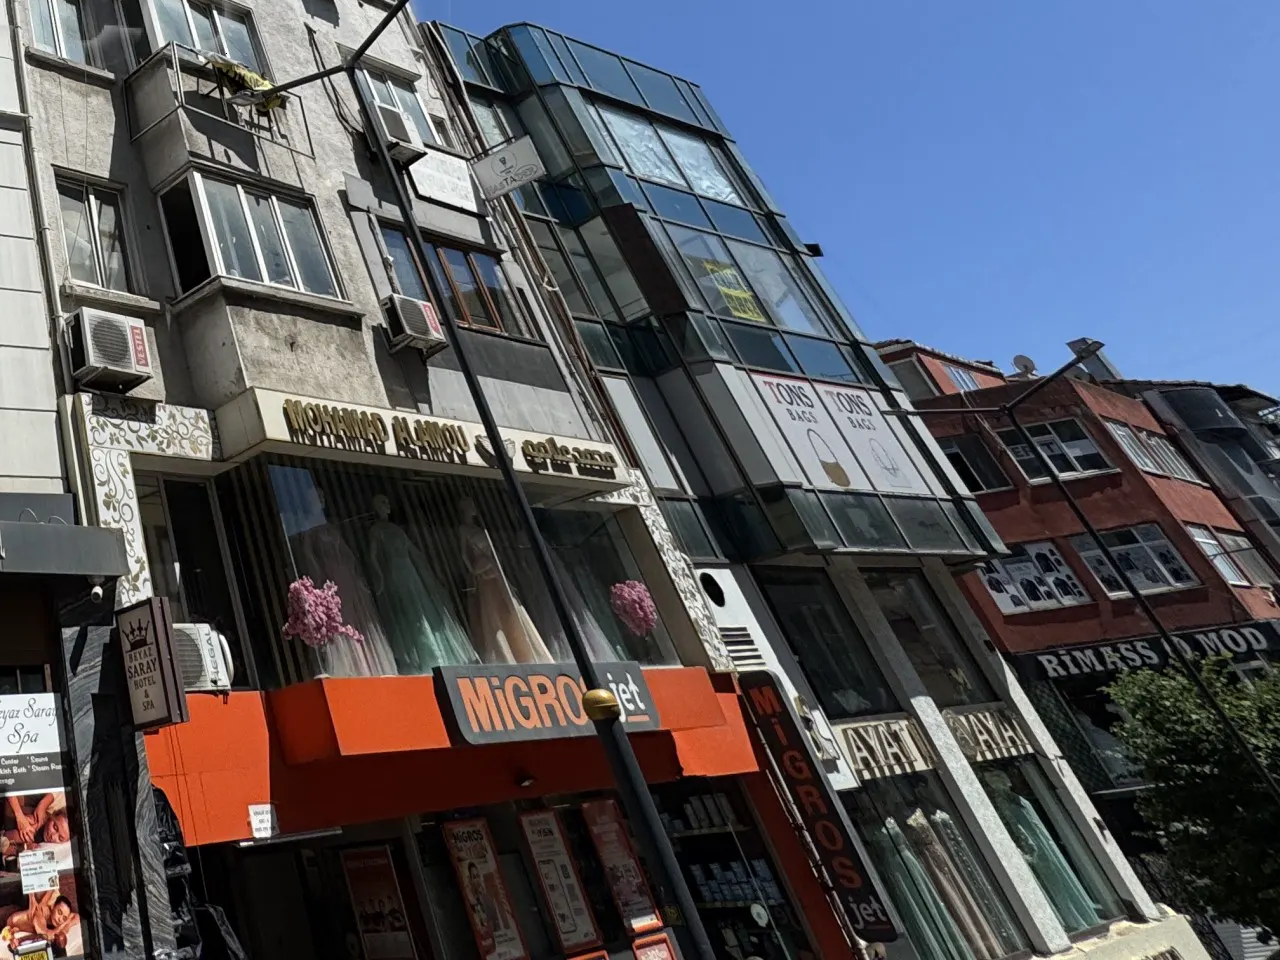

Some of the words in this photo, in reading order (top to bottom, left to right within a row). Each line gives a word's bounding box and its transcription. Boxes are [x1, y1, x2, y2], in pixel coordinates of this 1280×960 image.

[763, 380, 814, 408] TONS
[824, 390, 872, 416] TONS
[283, 398, 390, 443] MOHAMAD
[786, 408, 818, 424] BAGS
[847, 417, 876, 431] BAGS
[128, 646, 153, 663] BEYAZ
[127, 658, 157, 680] SARAY
[133, 675, 156, 690] HOTEL
[142, 700, 156, 712] SPA
[456, 674, 588, 733] MiGRO
[607, 672, 646, 723] jet
[7, 722, 40, 754] Spa
[851, 894, 888, 930] jet
